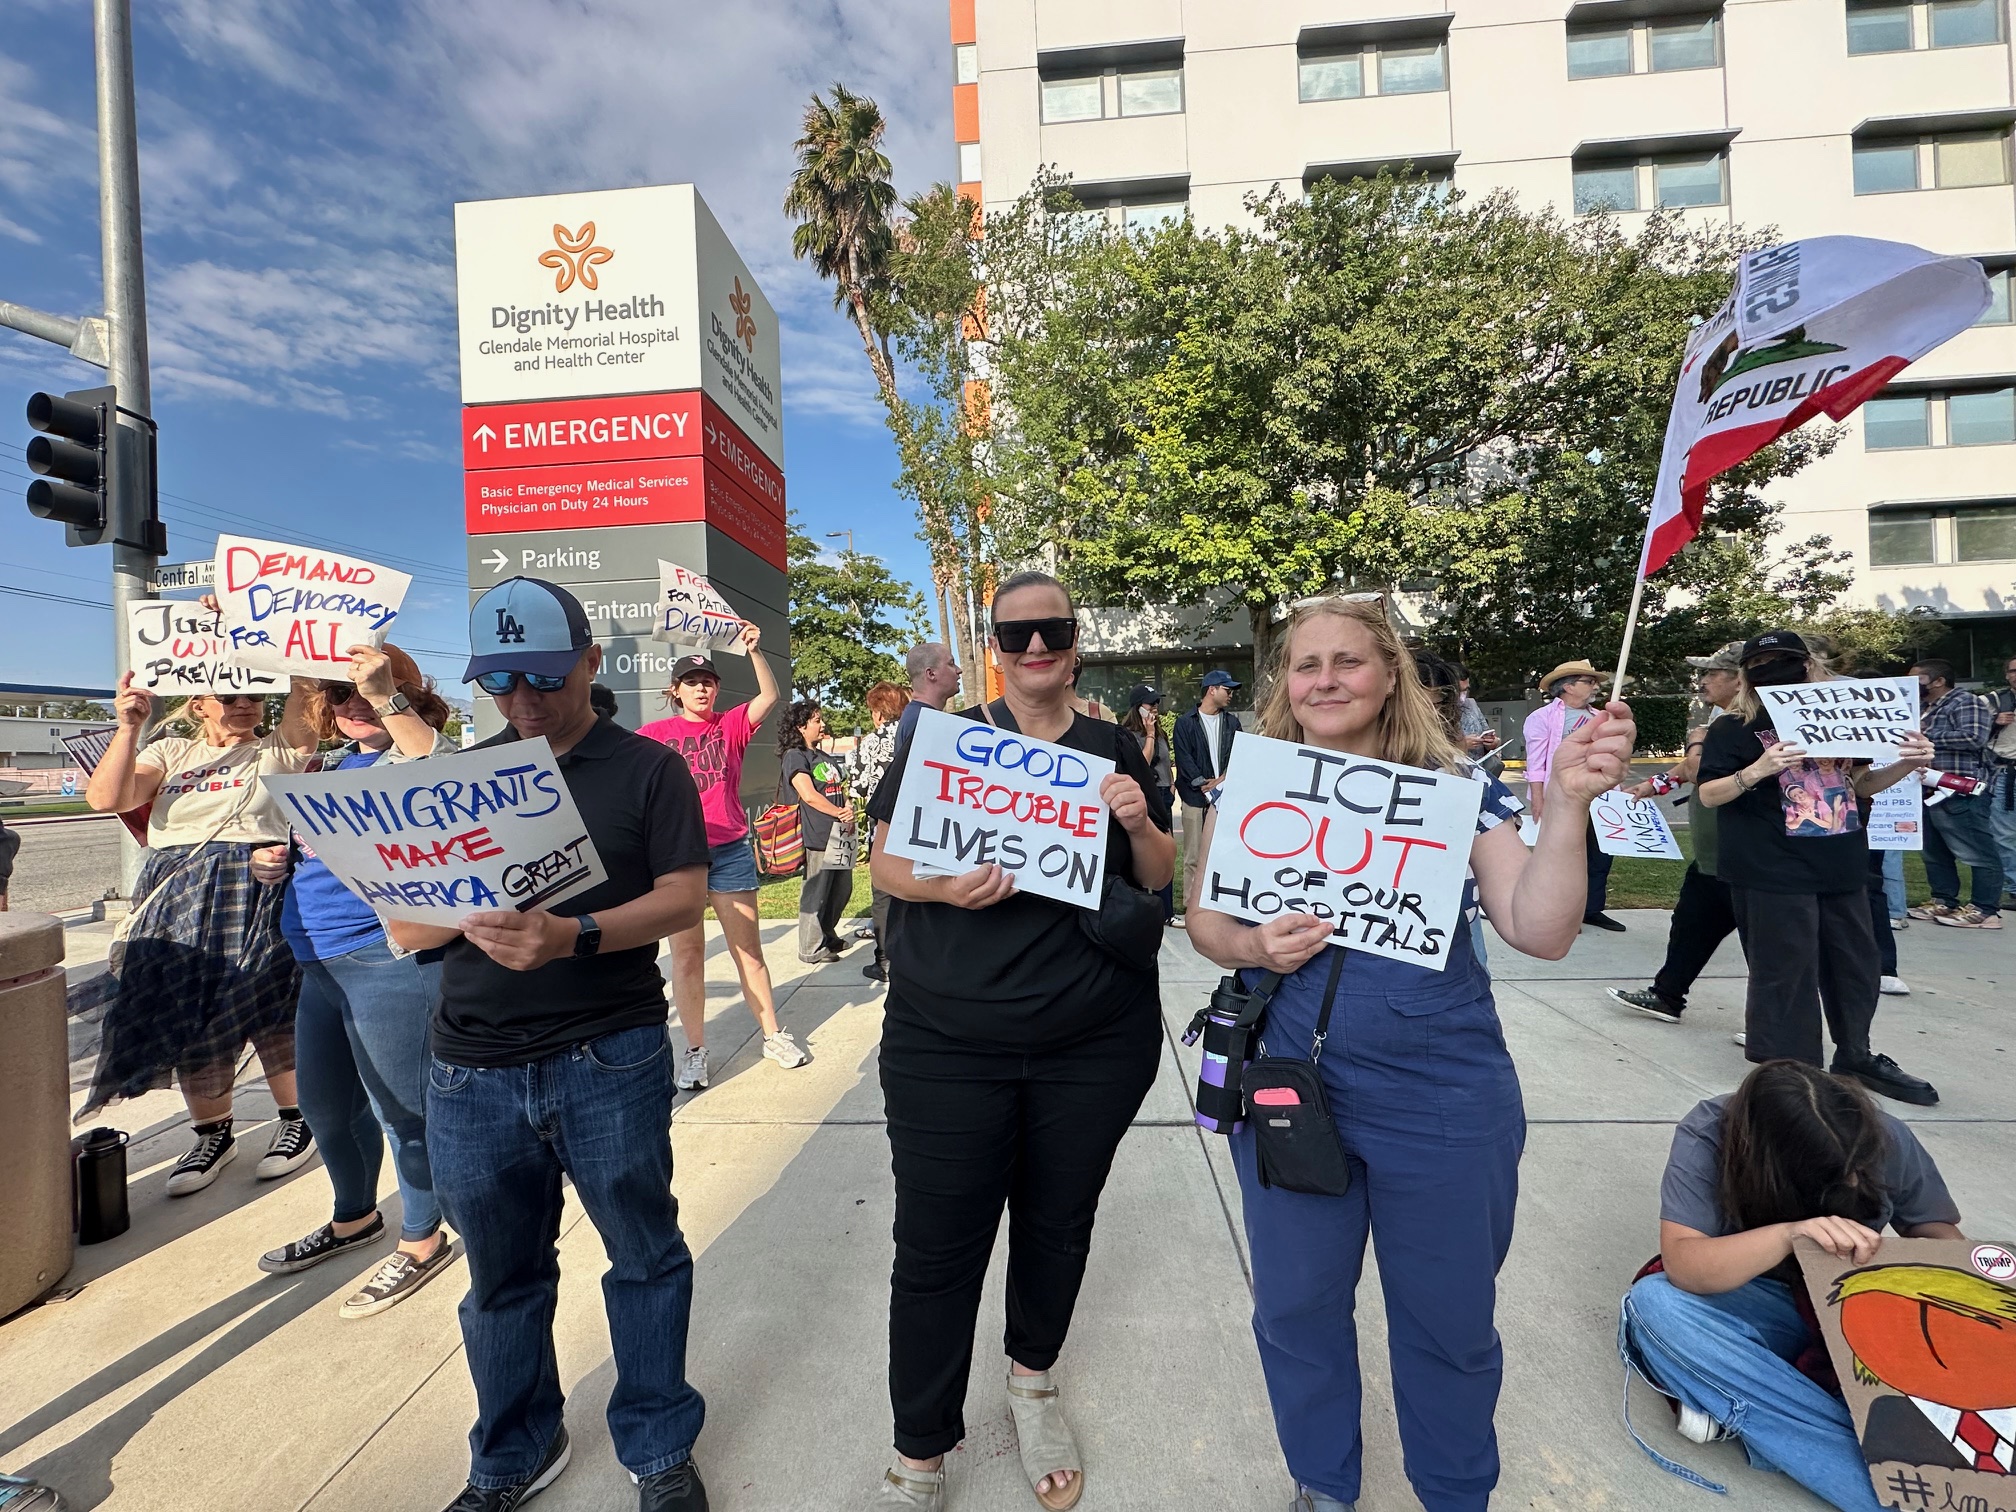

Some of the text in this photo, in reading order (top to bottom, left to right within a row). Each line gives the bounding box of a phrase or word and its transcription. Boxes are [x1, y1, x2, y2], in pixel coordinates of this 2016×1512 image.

[491, 294, 664, 333] Dignity Health
[479, 326, 680, 355] Glendale Memorial Hospital
[711, 311, 773, 405] Dignity Health
[514, 351, 645, 371] and Health Center
[707, 338, 778, 430] Glendale Memorial Hospital
[722, 375, 768, 433] and Health Center
[1700, 365, 1850, 428] REPUBLIC
[504, 412, 689, 449] EMERGENCY
[481, 476, 689, 499] Basic Emergency Medical Services
[719, 430, 782, 506] EMERGENCY
[481, 494, 649, 517] Physician on Duty 24 Hours
[155, 566, 198, 587] Central
[227, 547, 375, 593] DEMAND
[522, 546, 601, 570] Parking
[249, 584, 398, 631] DEMOCRACY
[667, 589, 736, 616] FOR PATIE
[230, 620, 353, 662] FOR ALL
[496, 608, 525, 643] LA
[665, 608, 744, 646] DIGNITY
[1768, 686, 1896, 705] DEFEND
[1793, 706, 1910, 722] PATIENTS
[1795, 723, 1910, 746] RIGHTS
[956, 726, 1089, 788] GOOD
[159, 779, 245, 795] TROUBLE
[286, 763, 562, 837] IMMIGRANTS
[923, 760, 1100, 838] TROUBLE
[1284, 748, 1438, 826] ICE
[1597, 805, 1629, 841] NO
[1625, 799, 1666, 853] KINGS
[1657, 834, 1669, 844] IN
[1871, 835, 1909, 843] Security
[375, 826, 505, 871] MAKE
[909, 806, 1099, 894] LIVES ON
[1239, 801, 1448, 889] OUT
[350, 835, 589, 908] AMERICA GREAT
[1211, 871, 1446, 957] HOSPITALS
[1274, 867, 1427, 925] OF OUR
[1977, 1256, 2012, 1268] TRUMP
